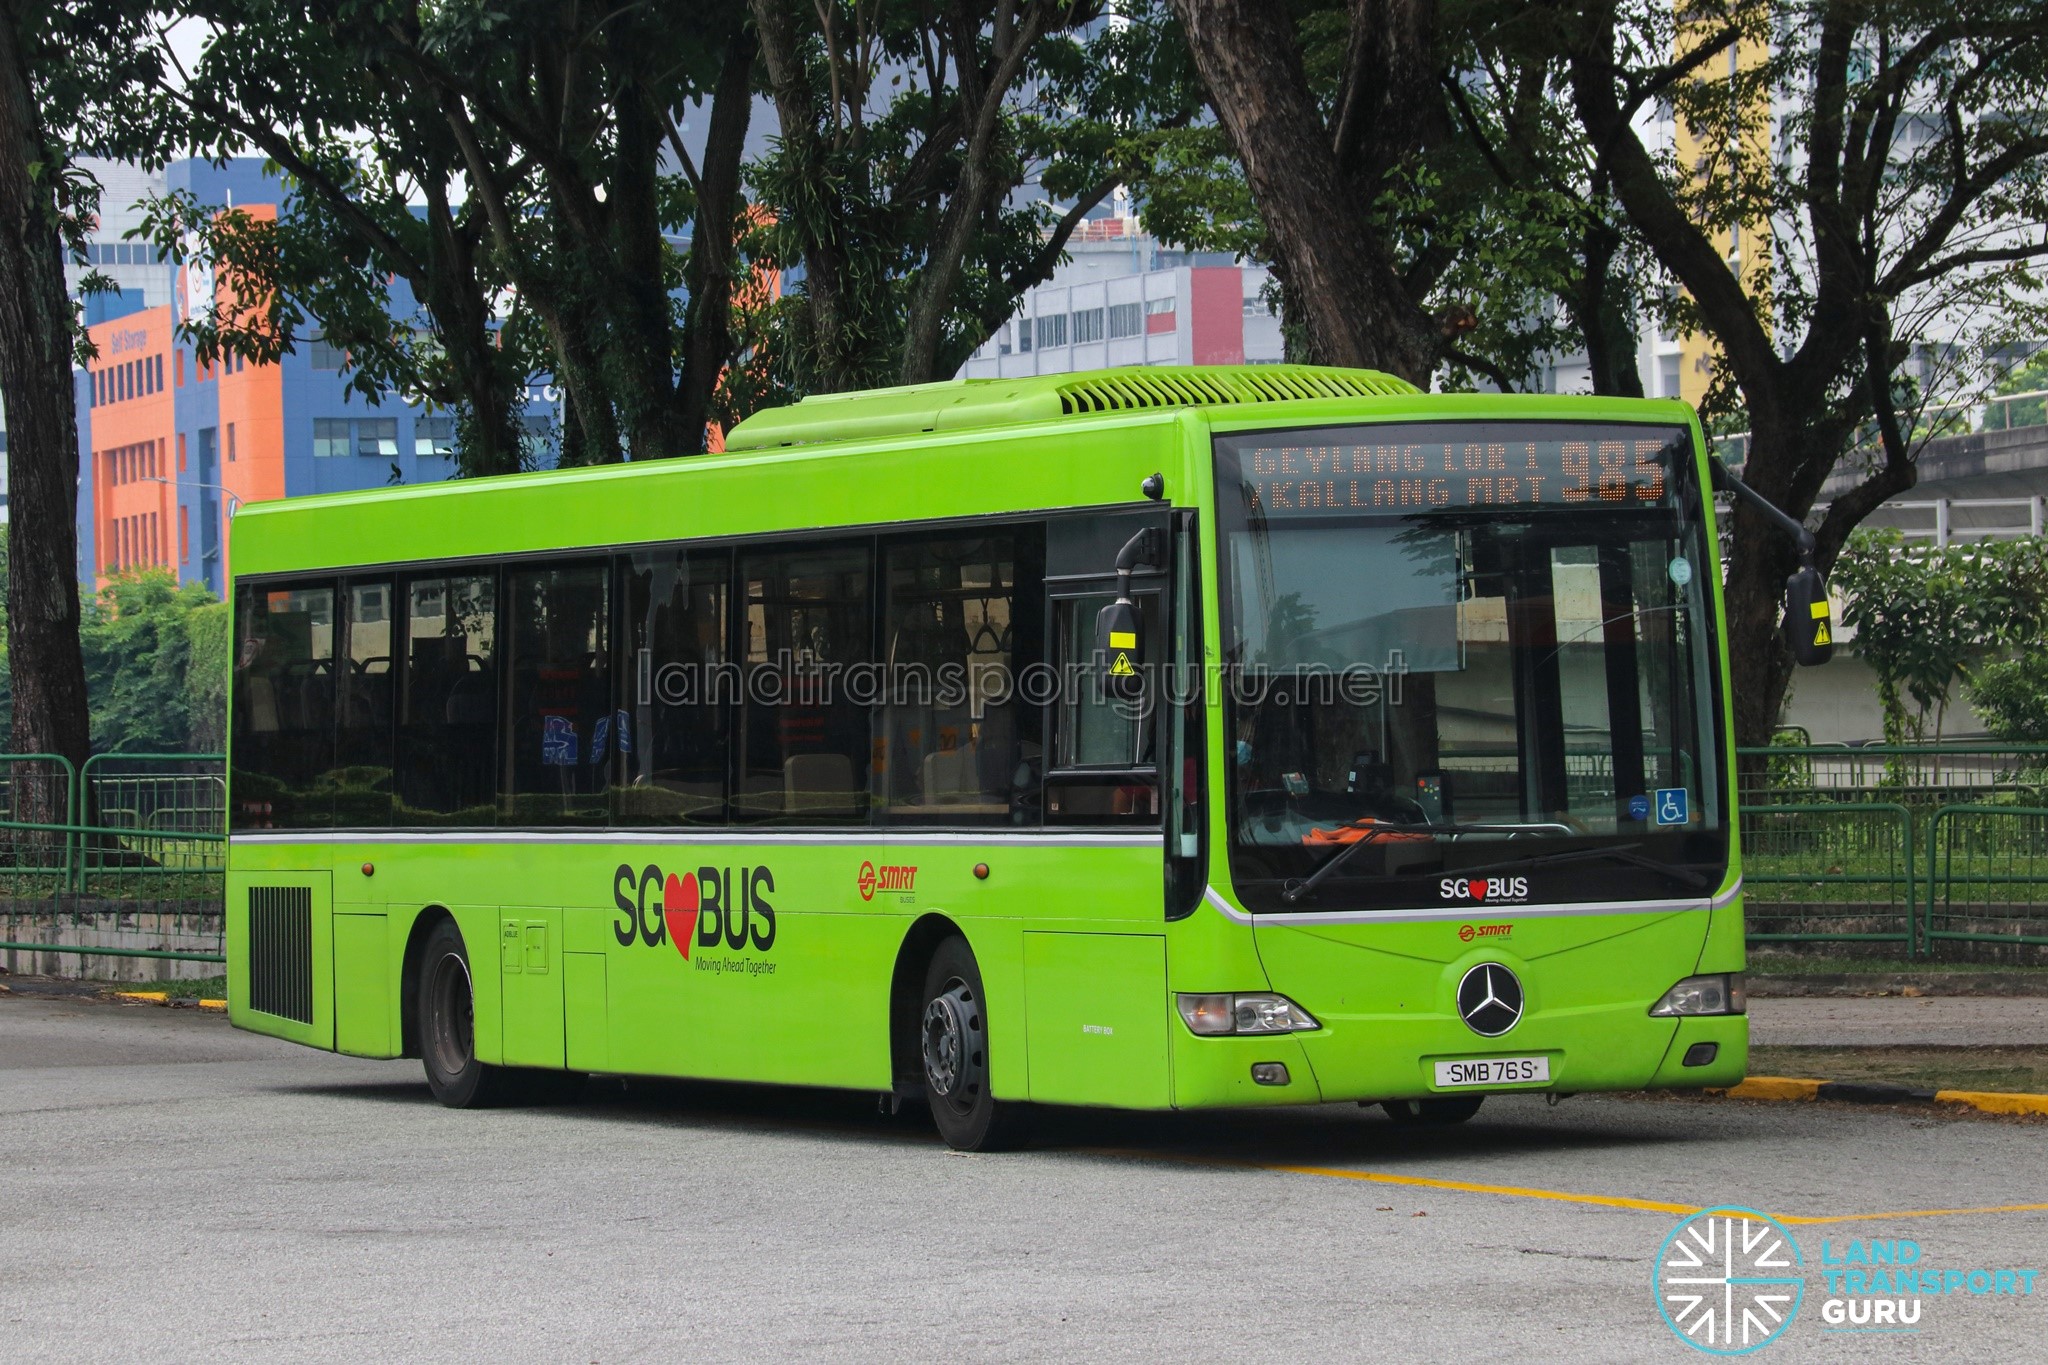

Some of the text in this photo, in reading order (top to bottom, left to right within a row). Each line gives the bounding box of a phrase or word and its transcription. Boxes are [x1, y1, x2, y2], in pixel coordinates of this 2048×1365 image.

[112, 329, 147, 354] Self Storage
[1254, 442, 1539, 474] GEYLANG LOR 1
[1562, 440, 1663, 501] 985
[1468, 476, 1546, 504] MRT
[877, 865, 918, 889] SMRT
[1477, 925, 1513, 936] SMRT
[695, 956, 776, 977] Moving Ahead Together
